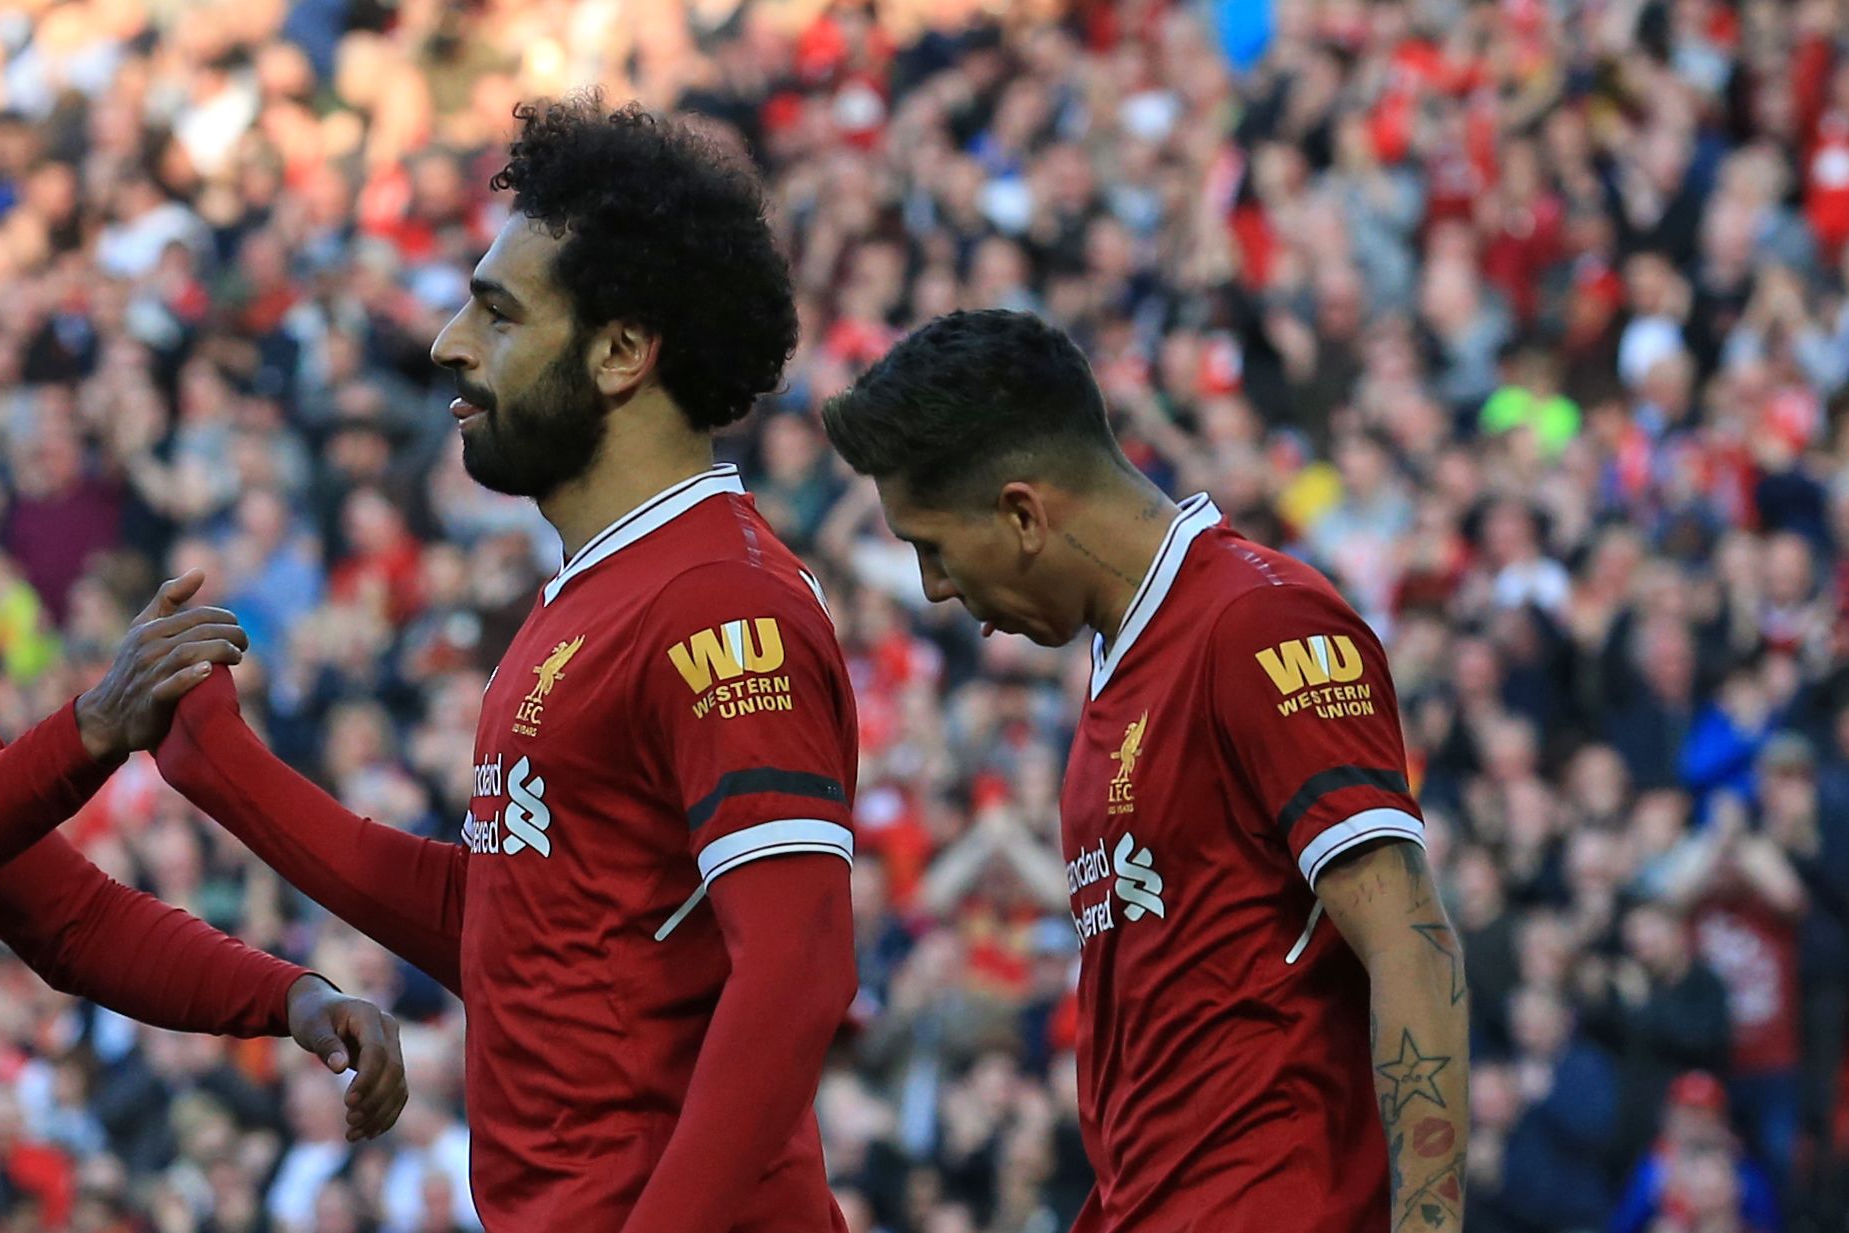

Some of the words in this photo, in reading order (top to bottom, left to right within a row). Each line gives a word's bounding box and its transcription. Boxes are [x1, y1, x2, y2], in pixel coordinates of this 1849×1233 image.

[667, 617, 785, 695] WU
[1255, 634, 1364, 696] WU
[692, 675, 790, 719] WESTERN
[718, 694, 793, 719] UNION
[1277, 684, 1371, 717] WESTERN
[1315, 700, 1375, 719] UNION
